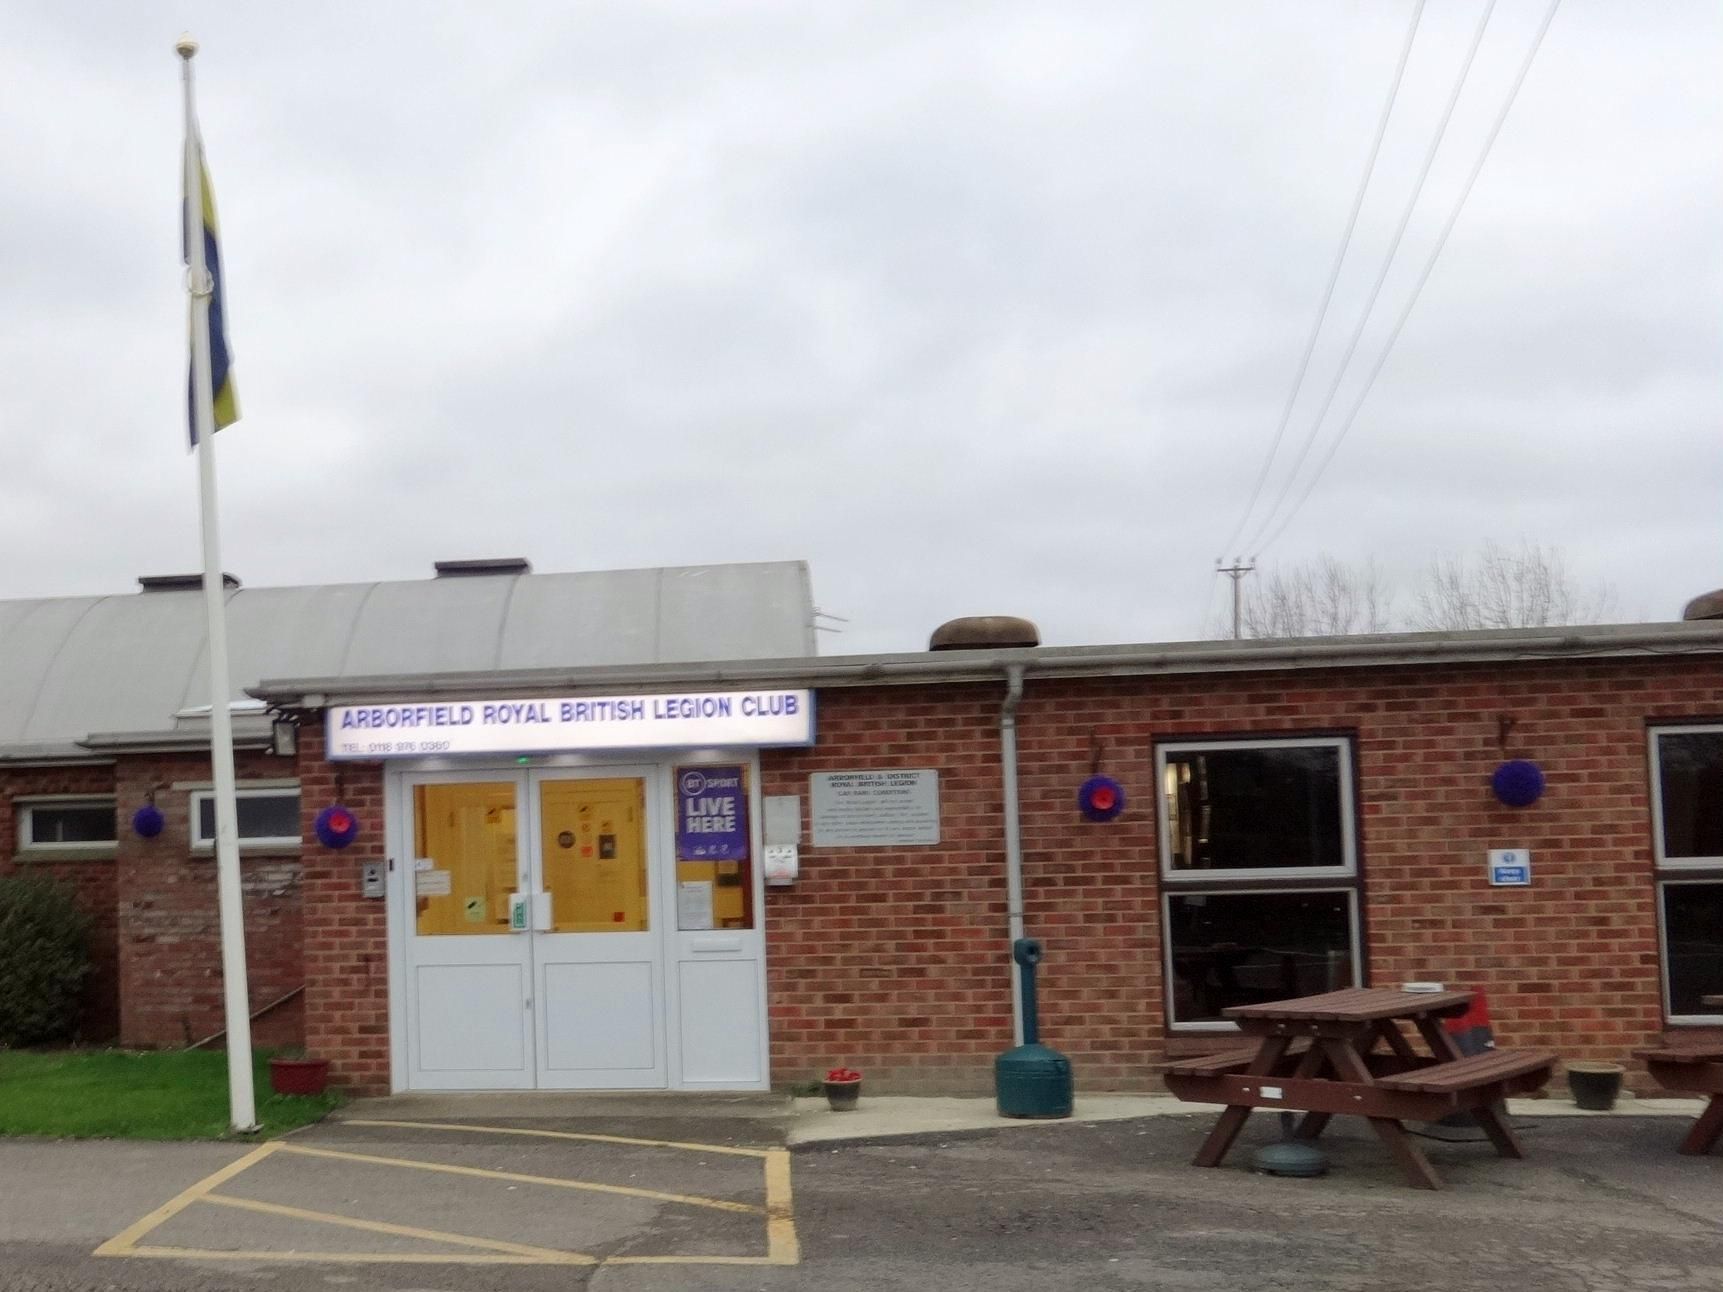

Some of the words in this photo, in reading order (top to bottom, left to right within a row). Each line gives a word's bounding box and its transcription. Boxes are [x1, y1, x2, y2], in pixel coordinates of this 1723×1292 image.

[342, 705, 474, 729] ARBORFIELD
[481, 702, 552, 726] ROYAL
[560, 700, 645, 723] BRITISH
[653, 697, 732, 719] LEGION
[741, 694, 799, 717] CLUB
[686, 796, 736, 817] LIVE
[686, 816, 737, 834] HERE
